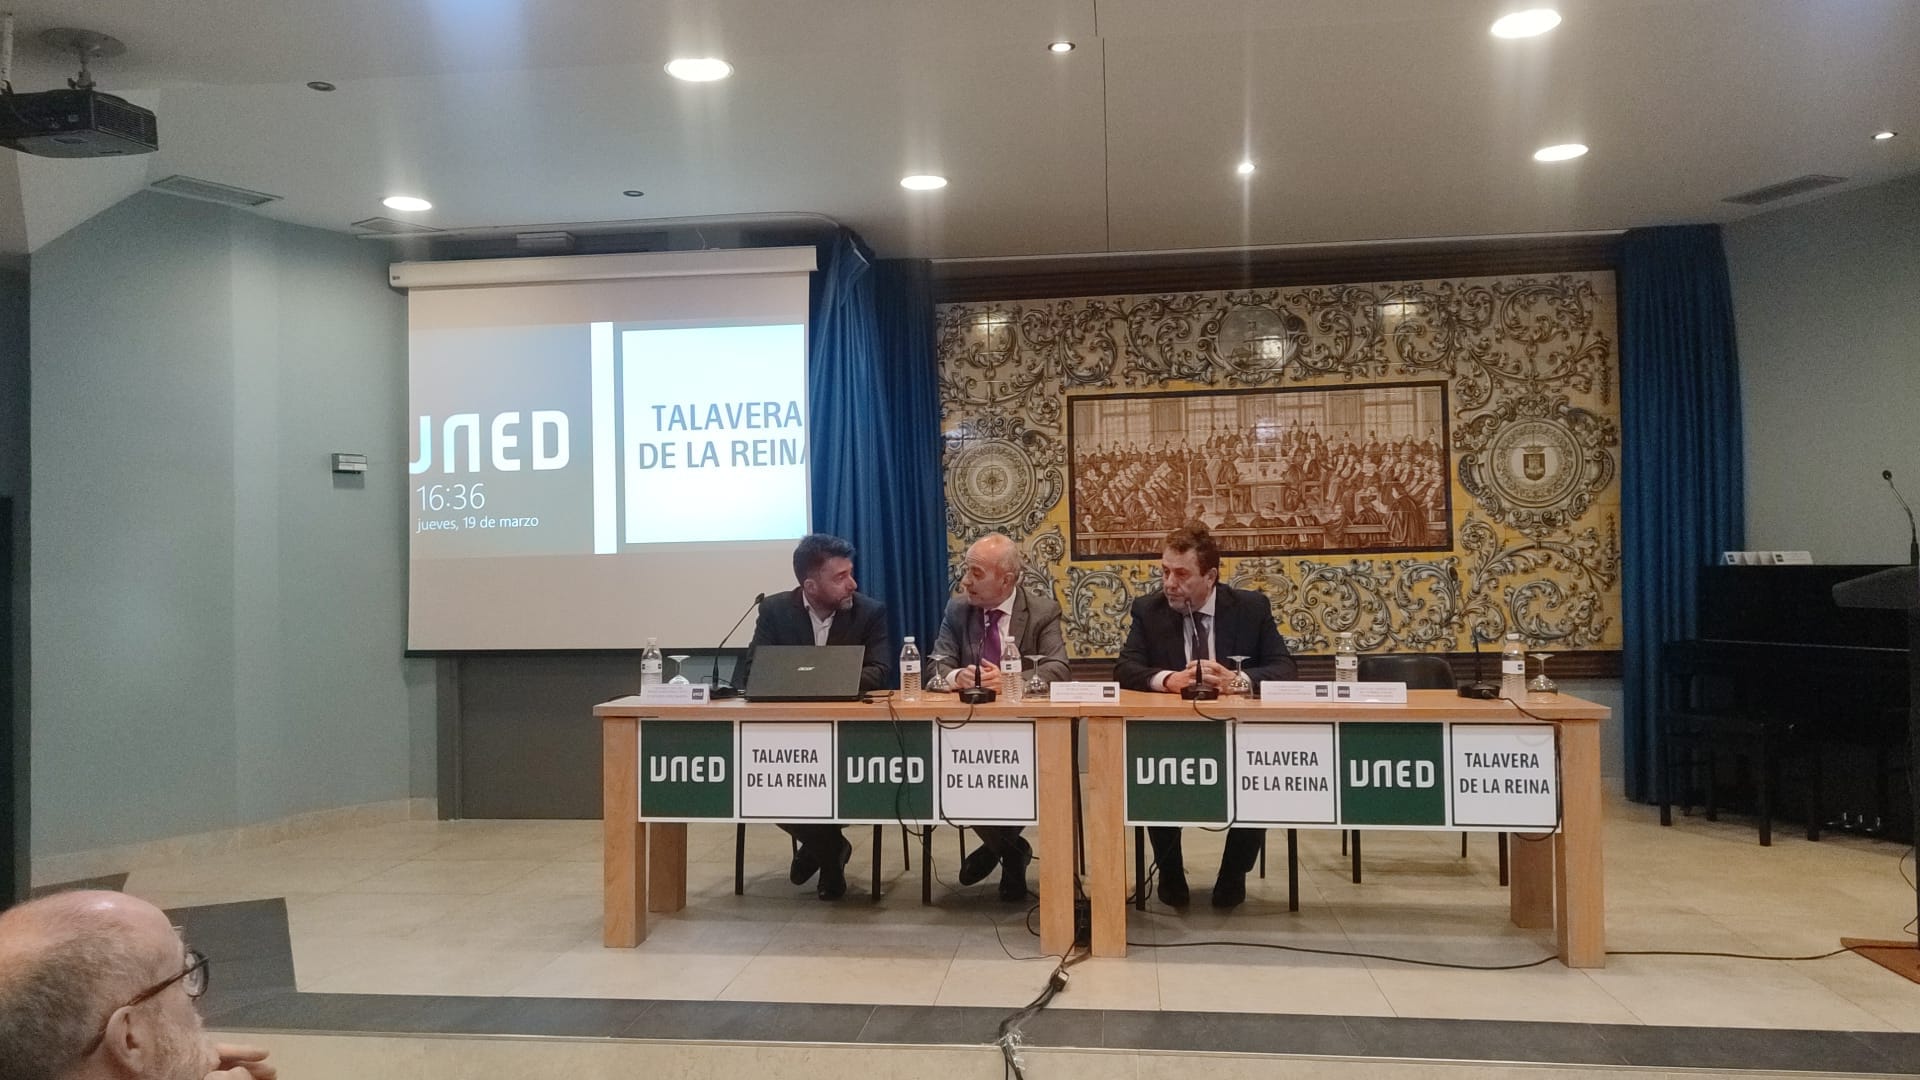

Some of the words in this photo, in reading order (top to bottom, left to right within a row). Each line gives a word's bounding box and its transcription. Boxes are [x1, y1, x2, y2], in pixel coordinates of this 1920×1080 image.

[651, 400, 803, 432] TALAVERA
[639, 442, 676, 470] DE
[687, 440, 720, 468] LA
[416, 483, 486, 511] 16:36
[416, 517, 459, 534] jueves,
[463, 516, 476, 529] 19
[480, 515, 496, 528] de
[499, 516, 540, 528] marzo
[752, 749, 819, 764] TALAVERA
[951, 749, 1020, 764] TALAVERA
[1246, 751, 1319, 767] TALAVERA
[1464, 752, 1540, 769] TALAVERA
[650, 755, 726, 783] UNED
[847, 756, 925, 784] UNED
[1136, 757, 1218, 786] UNED
[1350, 759, 1435, 789] UNED
[747, 773, 763, 788] DE
[767, 773, 783, 788] LA
[787, 773, 827, 788] REINA
[946, 774, 963, 789] DE
[967, 774, 984, 789] LA
[988, 774, 1029, 789] REINA
[1241, 776, 1259, 791] DE
[1264, 776, 1281, 791] LA
[1285, 776, 1329, 792] REINA
[1459, 778, 1478, 793] DE
[1482, 778, 1500, 794] LA
[1505, 779, 1550, 794] REINA
